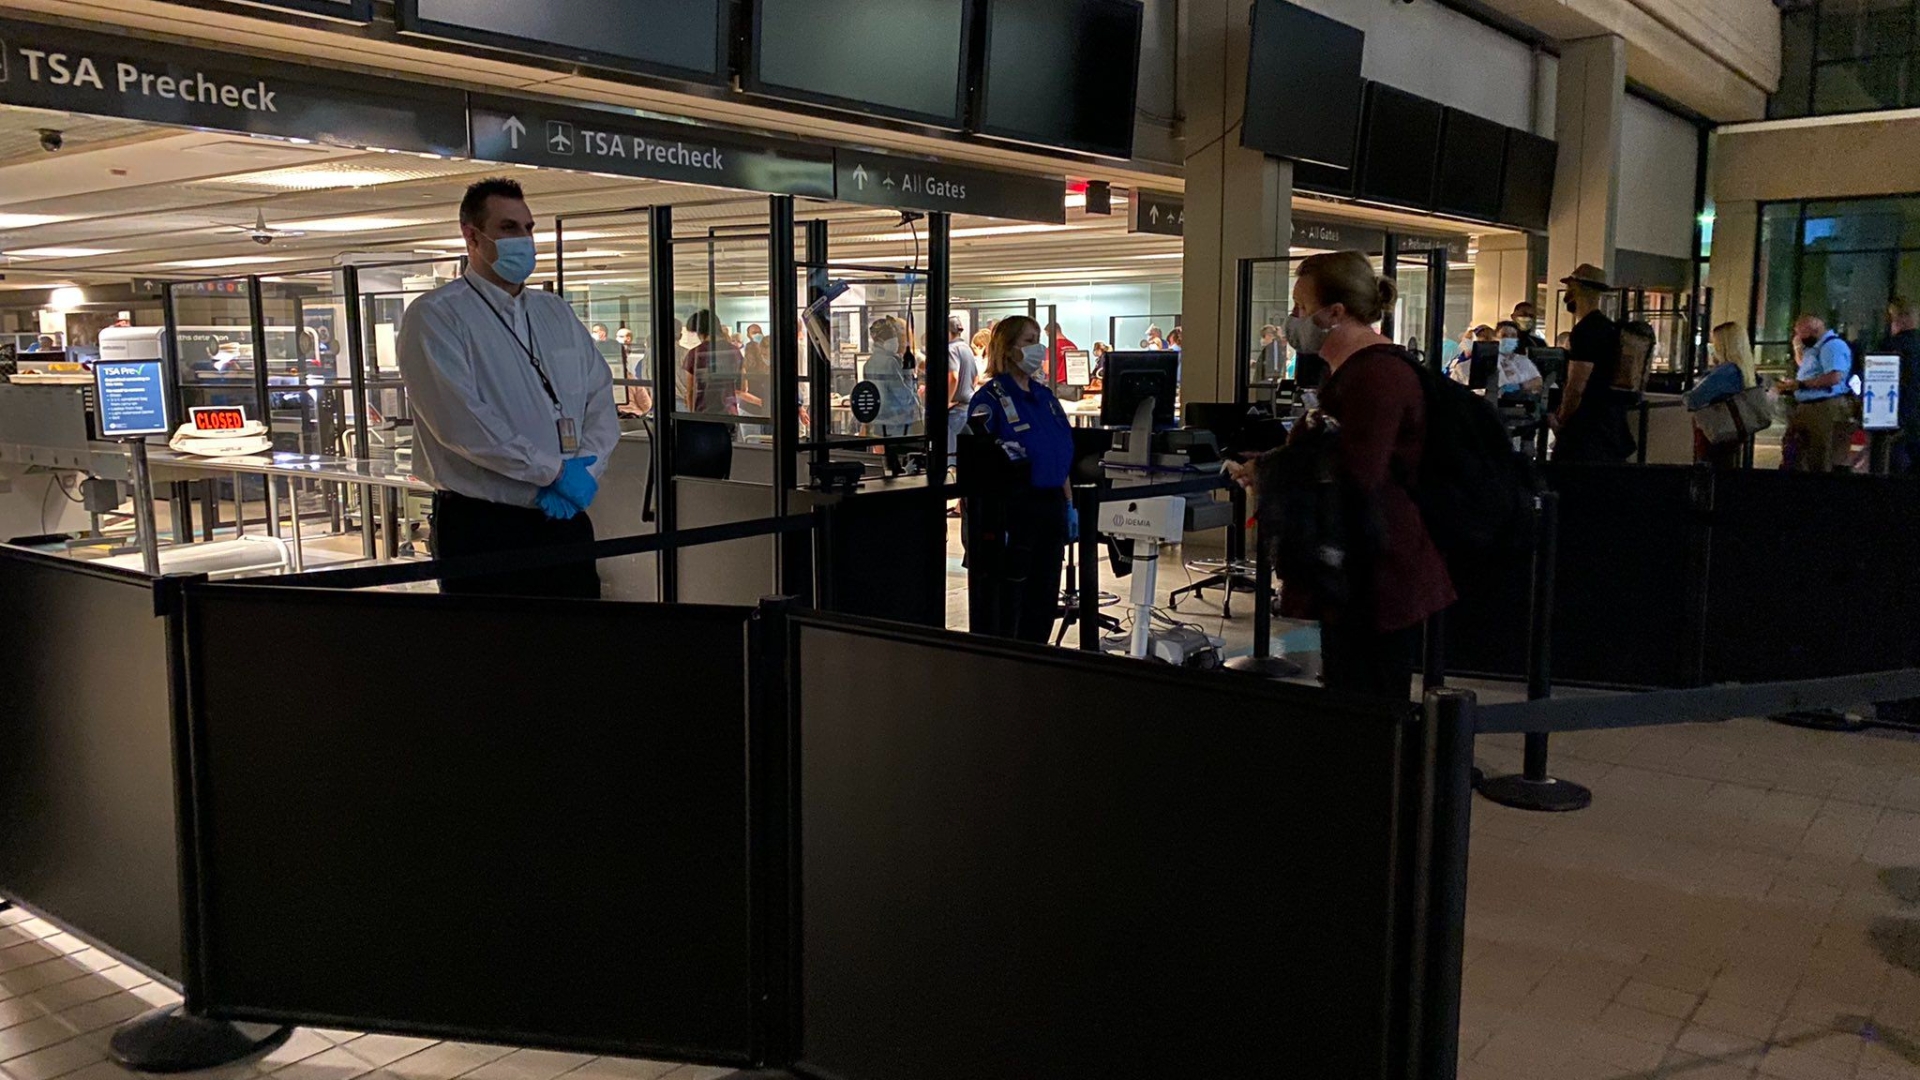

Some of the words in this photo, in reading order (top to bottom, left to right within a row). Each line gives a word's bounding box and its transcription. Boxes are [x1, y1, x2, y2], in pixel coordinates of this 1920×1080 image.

[19, 49, 104, 90] TSA
[116, 62, 278, 113] Precheck
[580, 130, 626, 159] TSA
[633, 137, 723, 171] Precheck
[901, 173, 922, 194] All
[925, 176, 966, 200] Gates
[1320, 227, 1339, 241] Gates
[196, 412, 242, 429] CLOSED
[1125, 517, 1151, 527] IDEMIA
